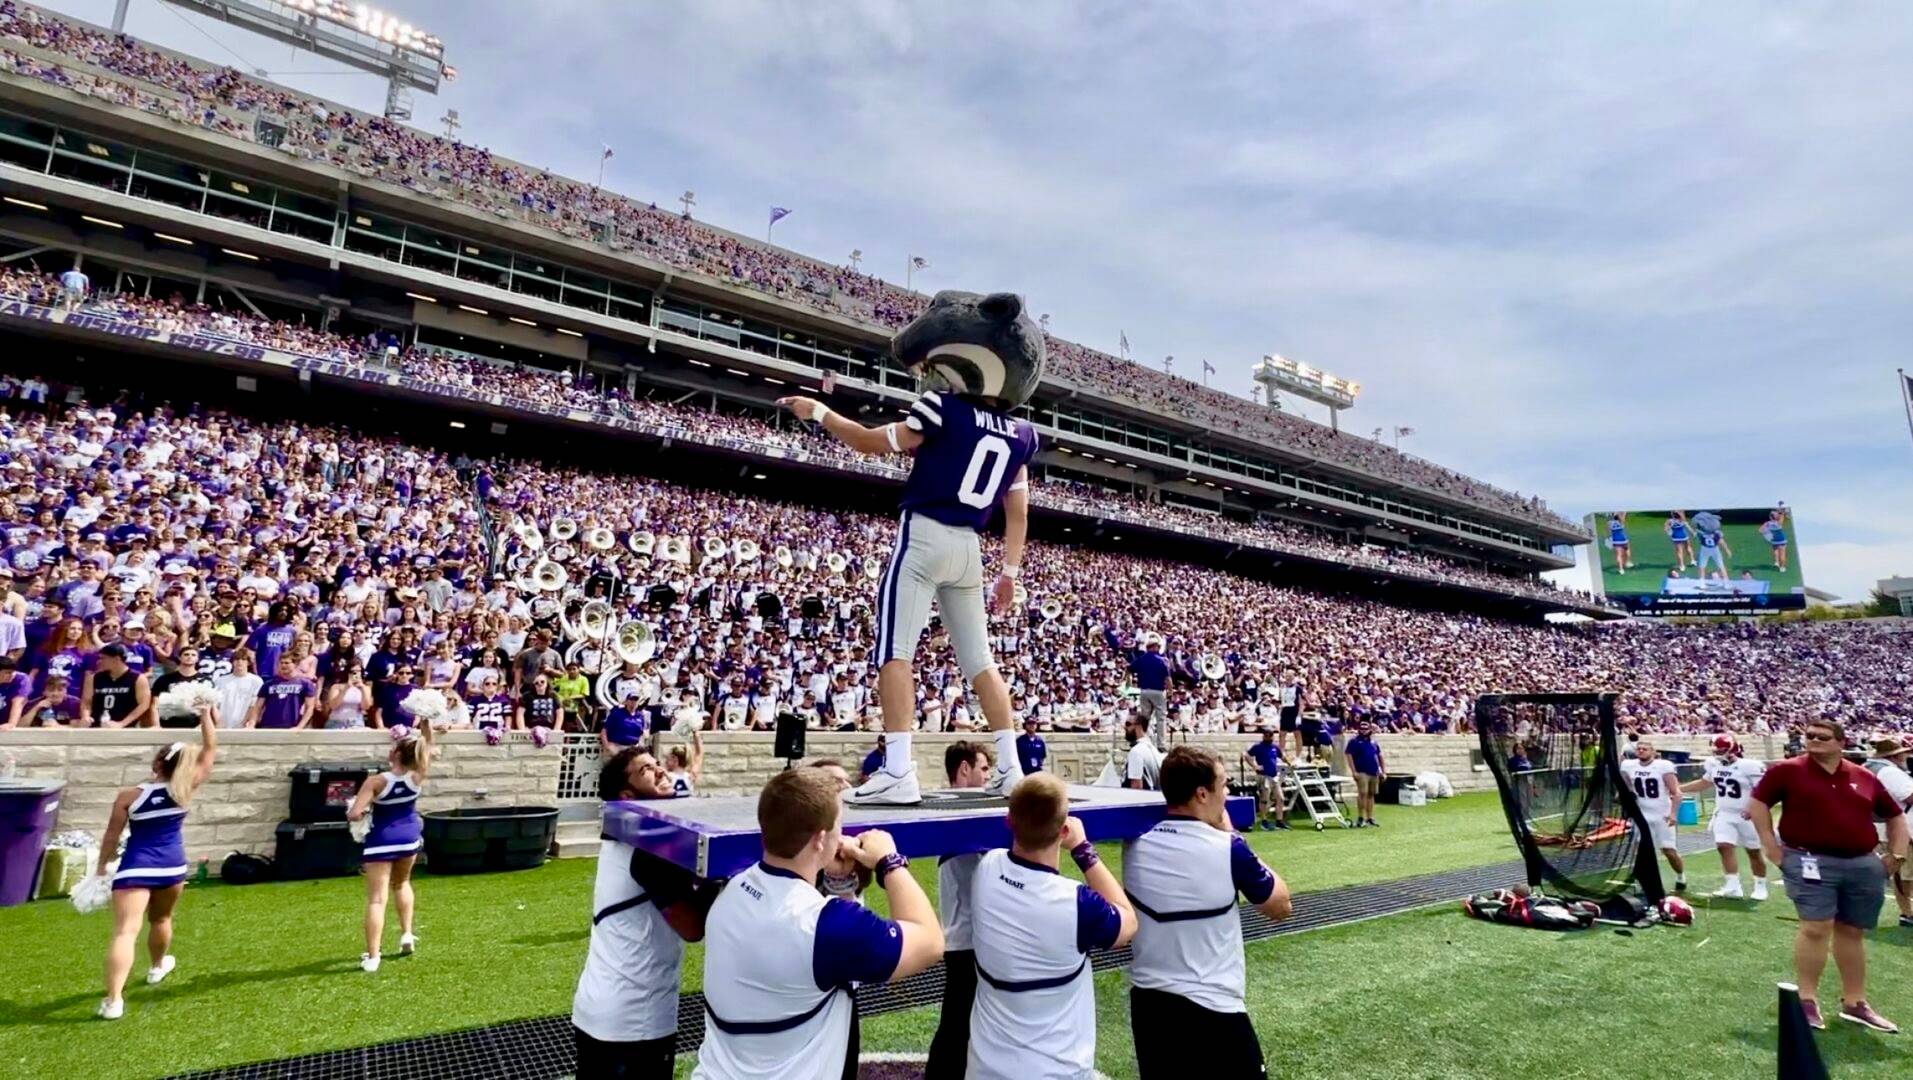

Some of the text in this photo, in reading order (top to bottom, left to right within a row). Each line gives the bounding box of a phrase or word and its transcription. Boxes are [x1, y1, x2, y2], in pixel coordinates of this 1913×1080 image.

[0, 302, 265, 360] AEL BISHOP 1997-98
[291, 358, 322, 371] 42
[328, 364, 390, 385] MARK
[399, 378, 495, 403] SIMONEAU
[615, 419, 659, 434] DAVID
[973, 407, 1019, 438] WILLIE
[957, 434, 1011, 510] 0
[103, 694, 116, 709] 0
[476, 702, 504, 723] 22
[1713, 777, 1742, 799] 53
[740, 880, 764, 901] K-STATE
[999, 874, 1025, 890] K-STATE
